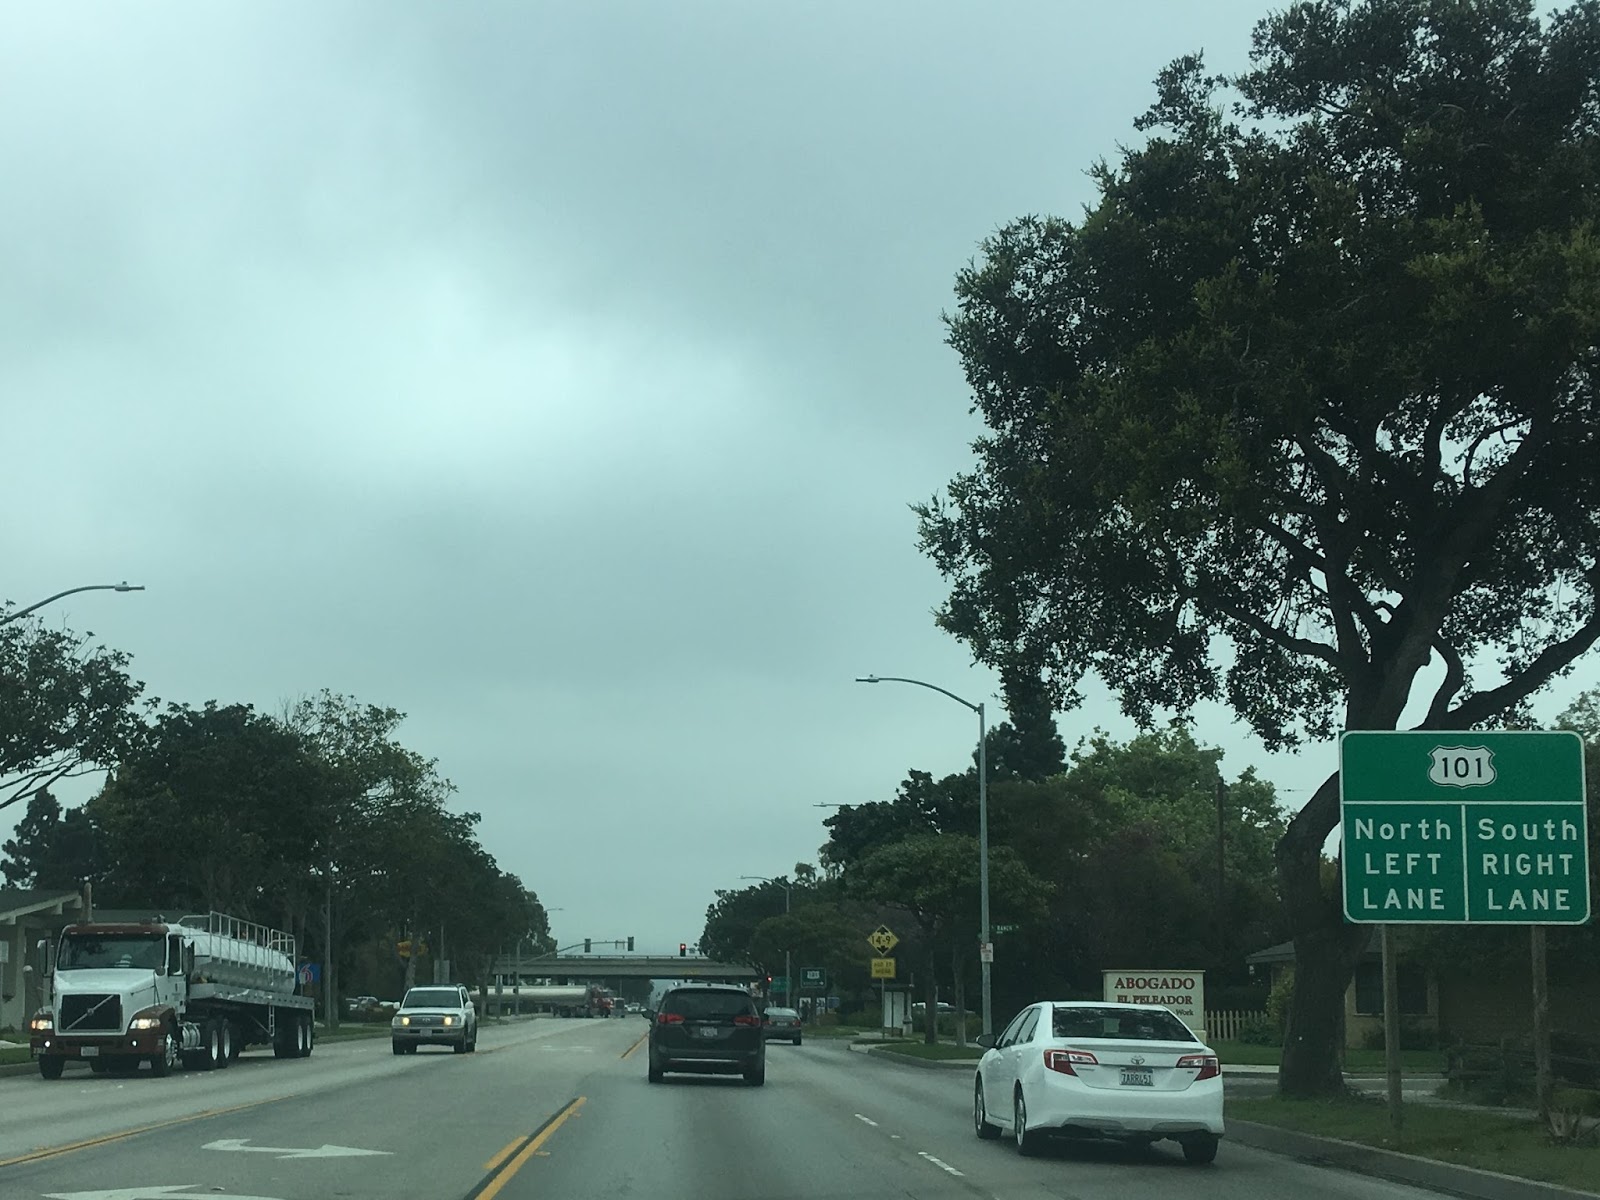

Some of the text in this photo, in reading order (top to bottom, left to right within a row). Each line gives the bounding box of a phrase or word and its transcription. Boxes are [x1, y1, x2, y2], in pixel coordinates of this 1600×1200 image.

[1441, 756, 1483, 778] 101
[1355, 818, 1452, 840] North
[1477, 818, 1577, 840] South
[1364, 852, 1442, 875] LEFT
[1482, 853, 1574, 875] RIGHT
[1363, 887, 1445, 910] LANE
[1487, 888, 1571, 911] LANE
[1114, 977, 1195, 990] ABOGADO
[1117, 994, 1193, 1005] EL PELEADOR
[1175, 1008, 1194, 1016] Work
